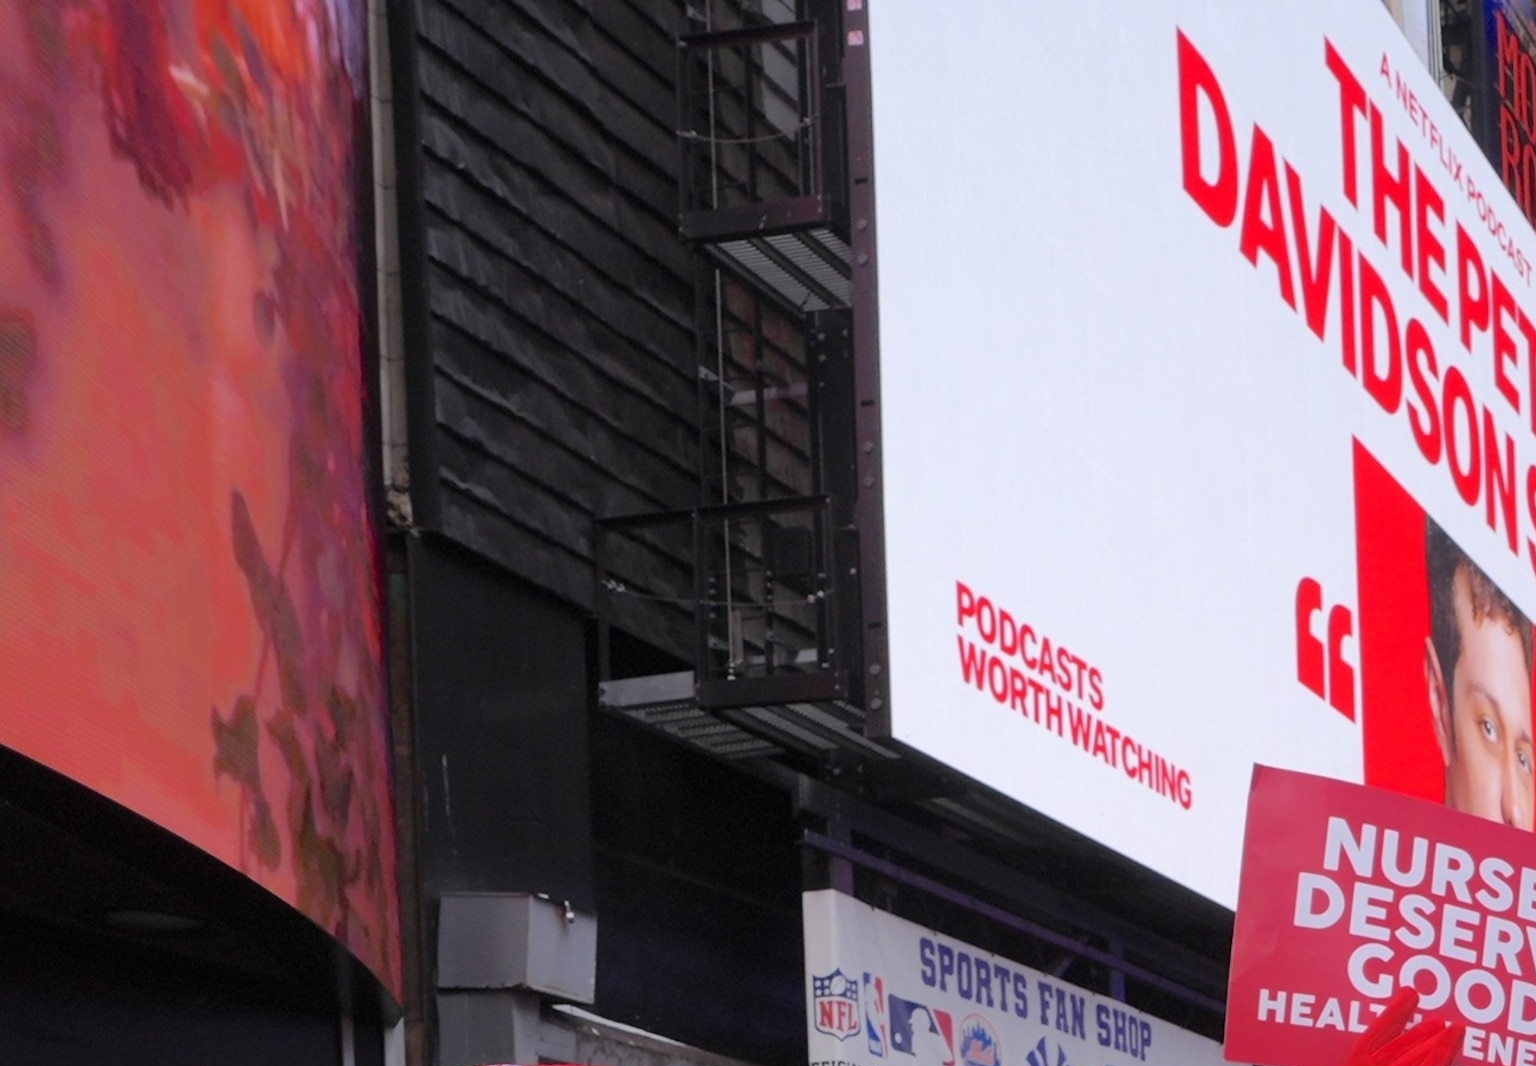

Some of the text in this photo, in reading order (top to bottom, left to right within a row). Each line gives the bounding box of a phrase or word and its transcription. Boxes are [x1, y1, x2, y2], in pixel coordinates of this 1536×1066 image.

[1324, 35, 1449, 328] THE
[1380, 50, 1532, 288] A NETFLIX PODCAST
[1176, 25, 1519, 556] DAVIDSON
[956, 579, 1104, 712] PODCASTS
[957, 633, 1192, 811] WORTH WATCHING
[819, 1000, 858, 1032] NFL
[919, 936, 1153, 1062] SPORTS FAN SHOP
